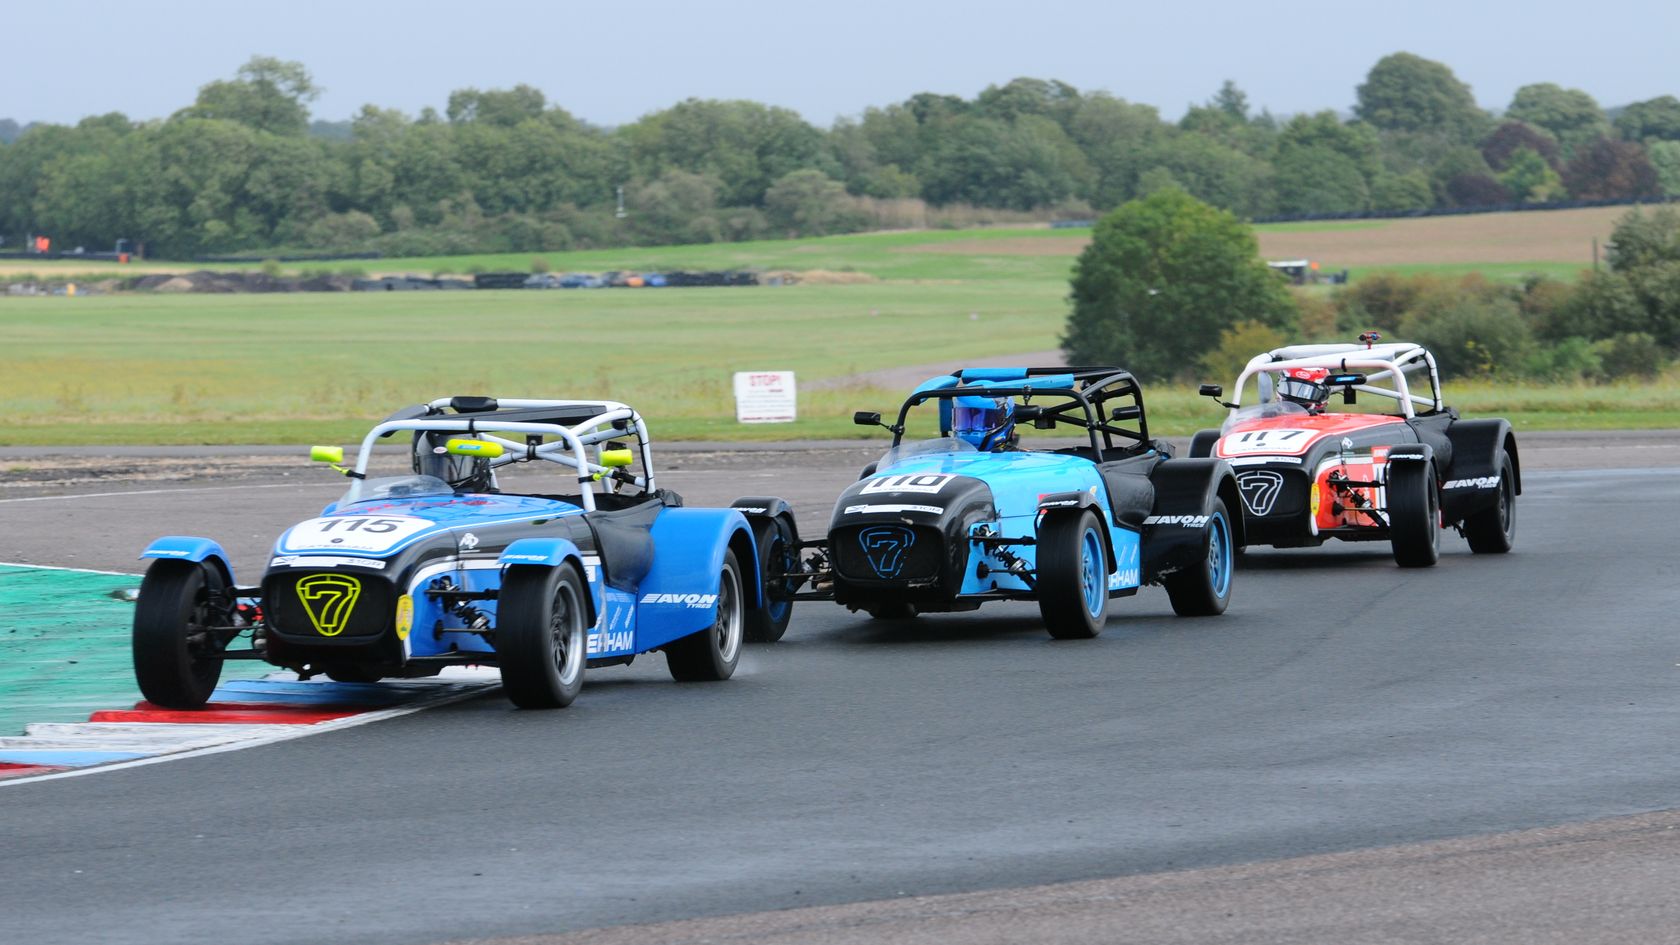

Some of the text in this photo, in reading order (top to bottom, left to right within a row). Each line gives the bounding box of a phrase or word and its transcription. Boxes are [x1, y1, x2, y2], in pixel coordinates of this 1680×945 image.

[1240, 430, 1305, 442] 117
[1455, 476, 1500, 488] AVON
[319, 518, 406, 533] 115
[1157, 515, 1209, 525] AVON
[657, 593, 718, 604] AVON
